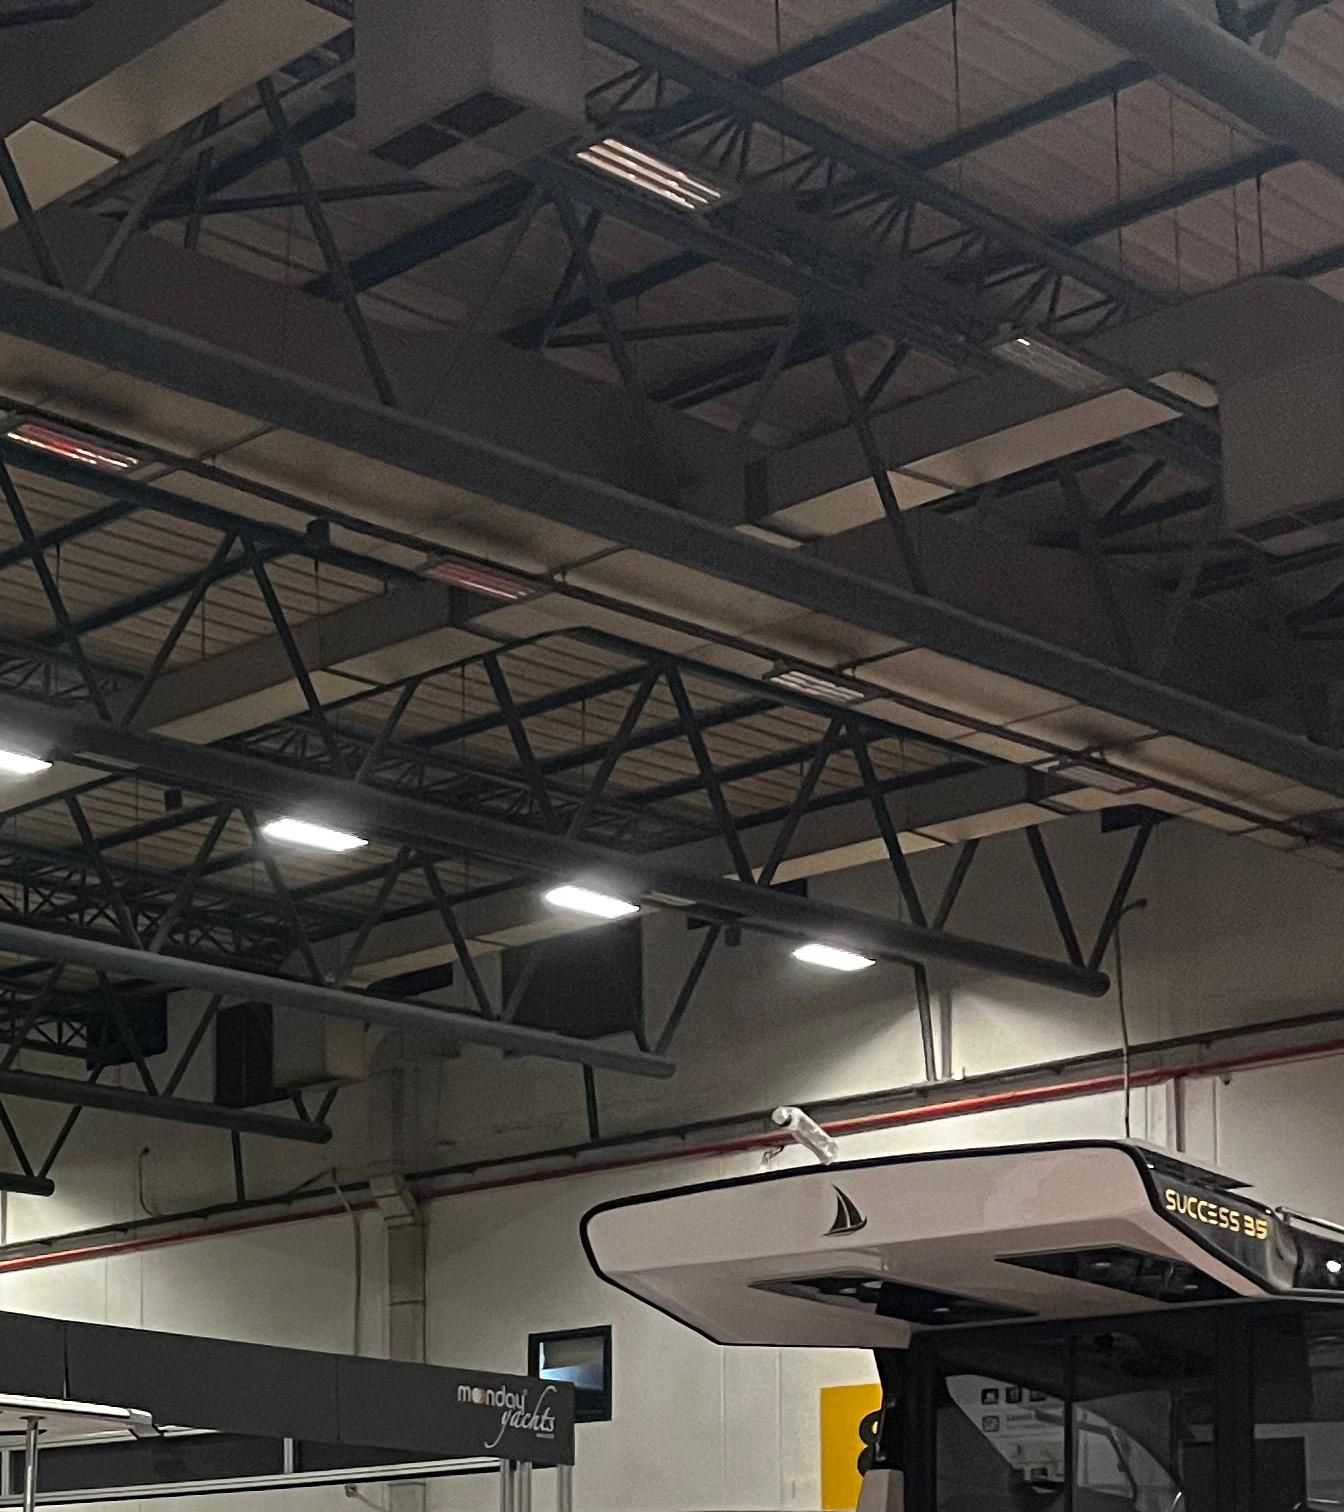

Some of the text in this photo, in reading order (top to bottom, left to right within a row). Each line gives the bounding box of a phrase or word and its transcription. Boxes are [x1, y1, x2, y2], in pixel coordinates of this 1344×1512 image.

[1165, 1188, 1269, 1241] SUCCESS 35
[484, 1385, 558, 1449] yachts
